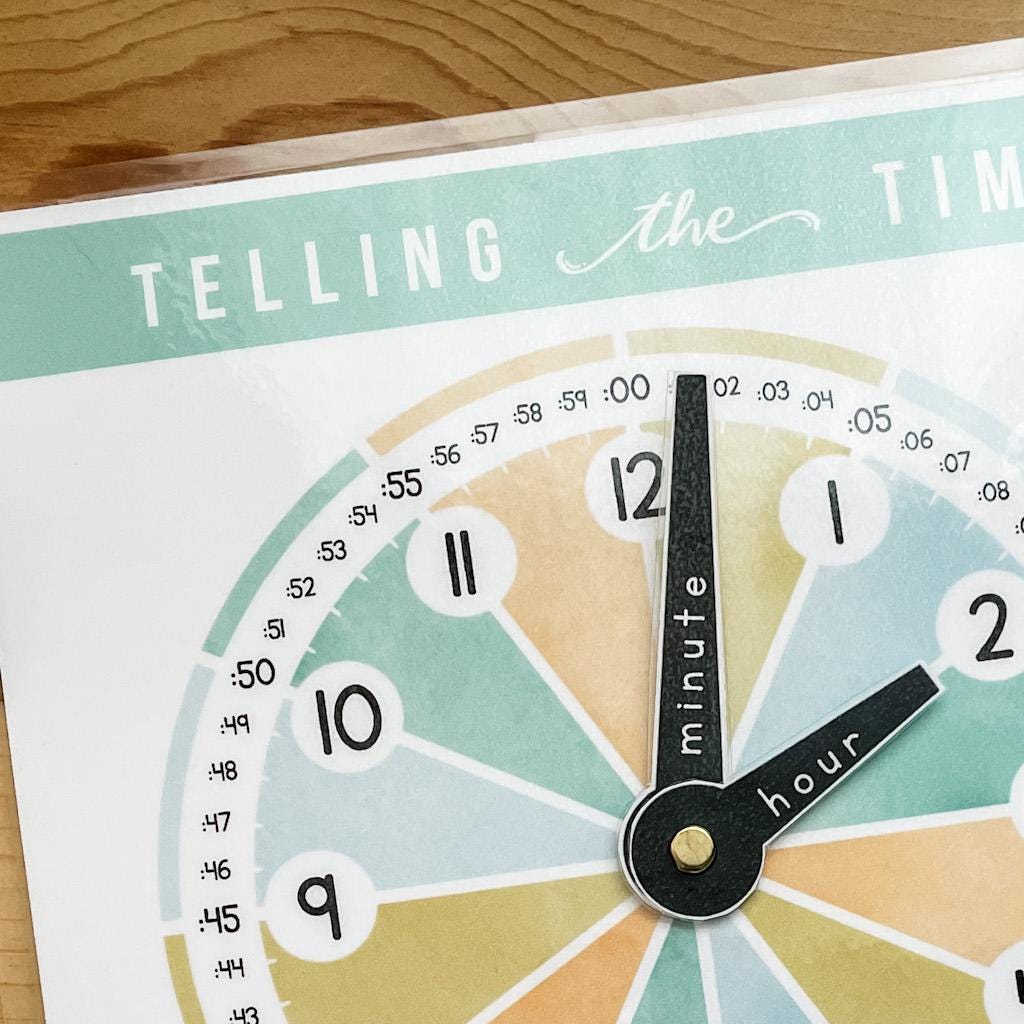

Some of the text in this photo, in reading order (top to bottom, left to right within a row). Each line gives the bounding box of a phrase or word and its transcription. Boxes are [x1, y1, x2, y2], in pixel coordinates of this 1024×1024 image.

[131, 216, 504, 328] TELLING
[556, 188, 820, 275] the
[603, 373, 651, 404] :00
[757, 380, 790, 402] :03
[558, 389, 588, 412] :59
[801, 389, 834, 412] :04
[513, 402, 543, 425] :58
[847, 404, 892, 434] :05
[470, 422, 499, 445] :57
[900, 428, 934, 451] :06
[430, 443, 461, 466] :56
[939, 450, 971, 473] :07
[380, 467, 423, 500] :55
[609, 450, 668, 522] 12
[977, 480, 1010, 503] :08
[347, 503, 379, 527] :54
[827, 479, 845, 545] 1
[316, 539, 348, 562] :53
[444, 529, 477, 598] 11
[285, 576, 317, 600] :52
[263, 618, 286, 640] :51
[968, 593, 1015, 663] 2
[230, 657, 276, 690] :50
[673, 576, 707, 755] minute
[220, 713, 250, 736] :49
[315, 683, 383, 756] 10
[208, 759, 238, 782] :48
[757, 732, 859, 817] hour
[201, 810, 231, 833] :47
[200, 858, 232, 881] :46
[198, 903, 241, 934] :45
[296, 873, 342, 941] 9
[214, 957, 245, 980] :44
